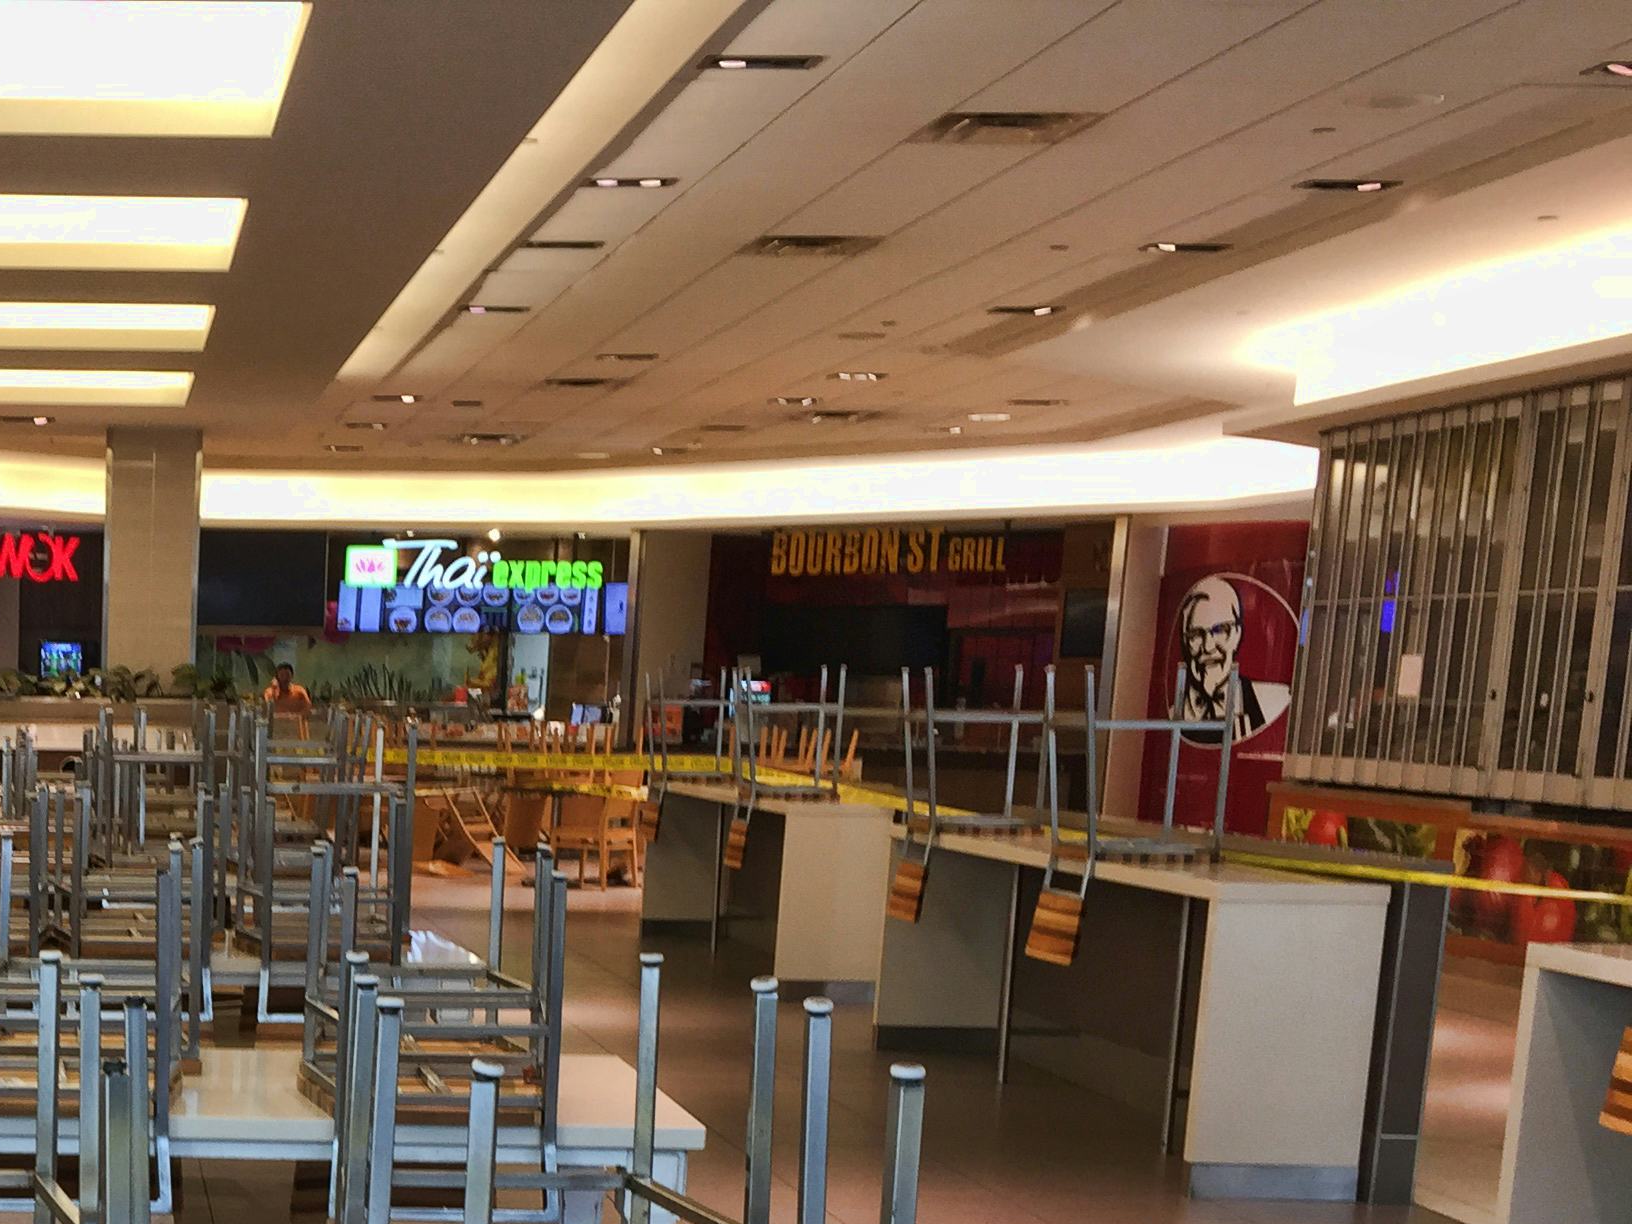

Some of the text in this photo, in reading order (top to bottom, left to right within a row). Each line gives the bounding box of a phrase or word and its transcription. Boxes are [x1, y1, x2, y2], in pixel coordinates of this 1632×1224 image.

[770, 526, 1007, 577] BOURBON ST GRILL
[491, 559, 604, 594] express
